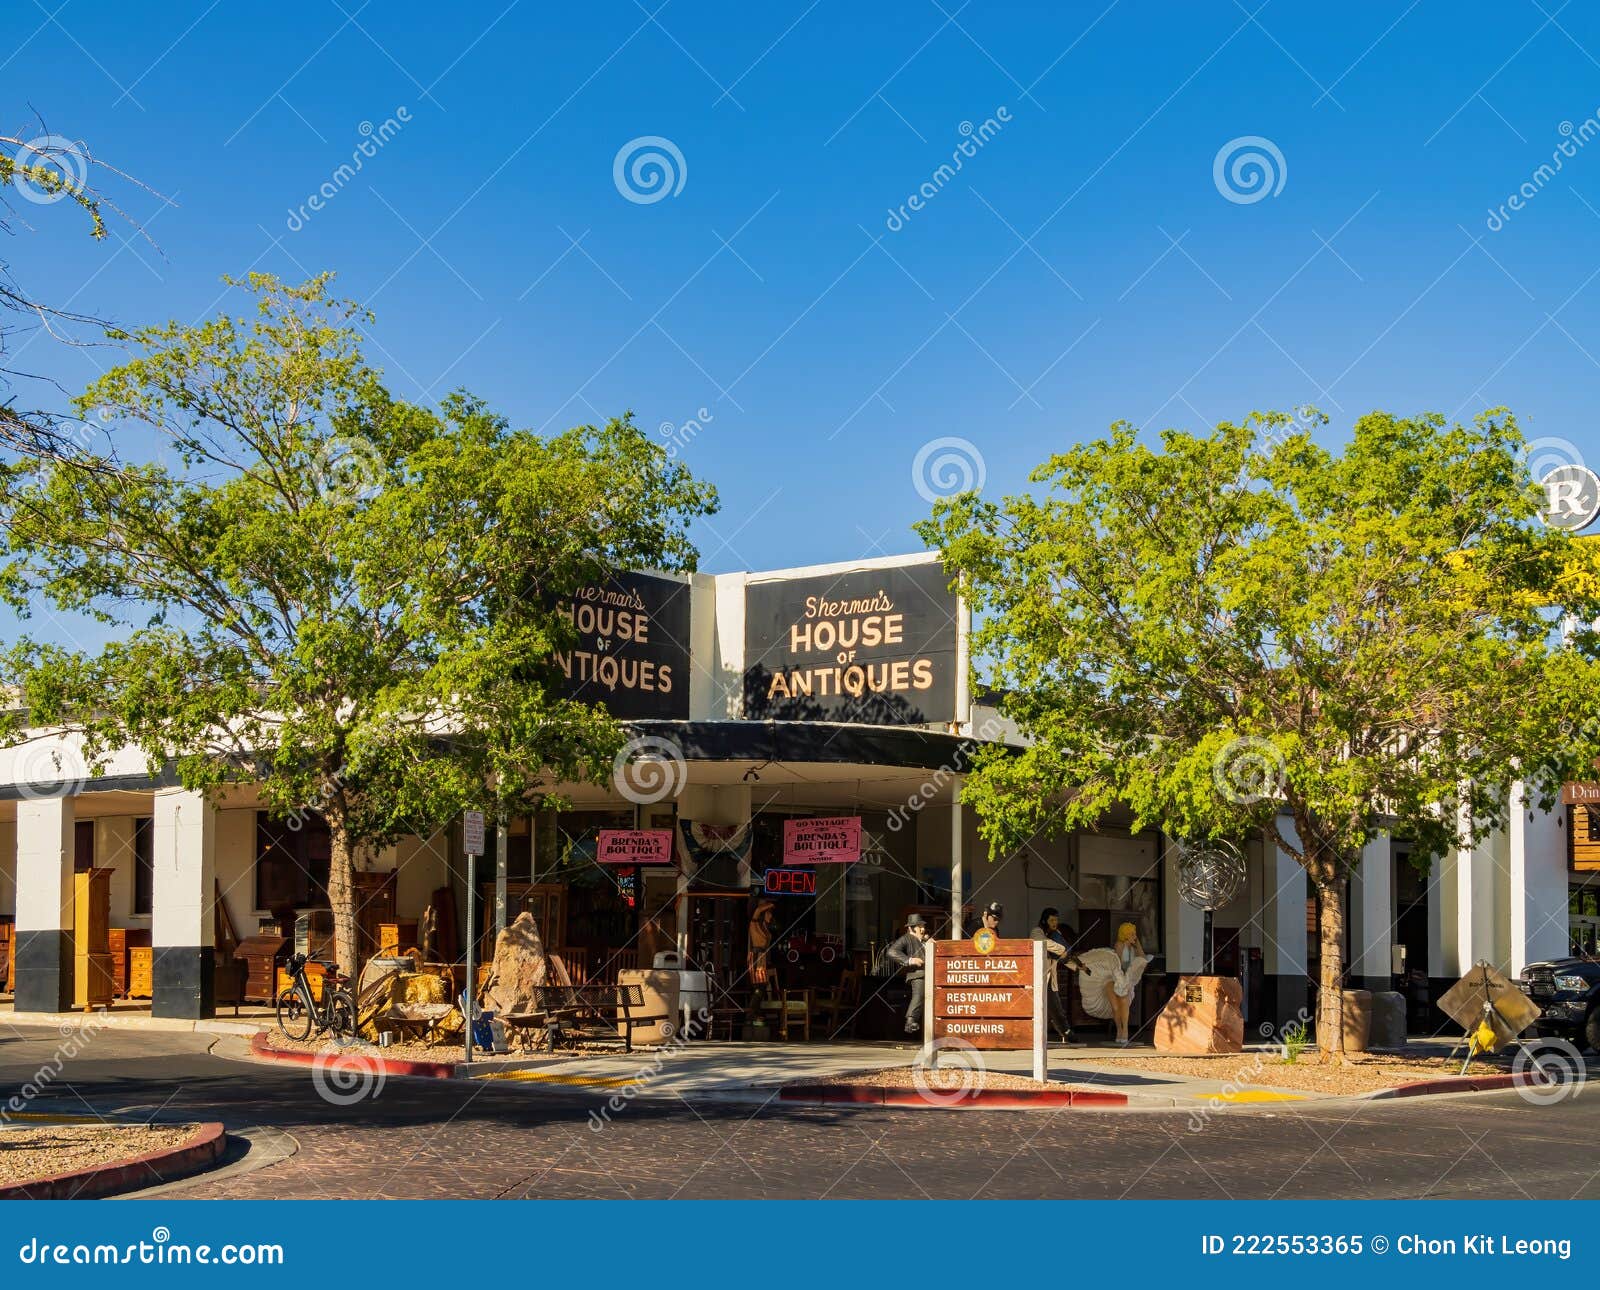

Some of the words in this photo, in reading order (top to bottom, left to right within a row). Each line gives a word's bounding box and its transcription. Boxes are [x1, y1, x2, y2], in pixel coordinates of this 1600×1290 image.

[575, 587, 646, 611] herman's
[805, 590, 894, 619] Sherman's
[790, 614, 903, 653] HOUSE
[597, 636, 612, 651] OF
[836, 650, 857, 665] OF
[552, 650, 673, 694] NTIQUES
[767, 659, 933, 700] ANTIQUES
[611, 837, 660, 846] BRENDA'S
[796, 831, 848, 842] BRENDA'S
[606, 845, 663, 854] BOUTIQUE
[794, 840, 848, 851] BOUTIQUE
[766, 871, 816, 893] OPEN
[946, 960, 980, 970] HOTEL
[984, 960, 1018, 970] PLAZA
[946, 974, 990, 984] MUSEUM
[946, 992, 1013, 1003] RESTAURANT
[946, 1004, 977, 1015] GIFTS
[946, 1023, 1005, 1034] SOUVENIRS
